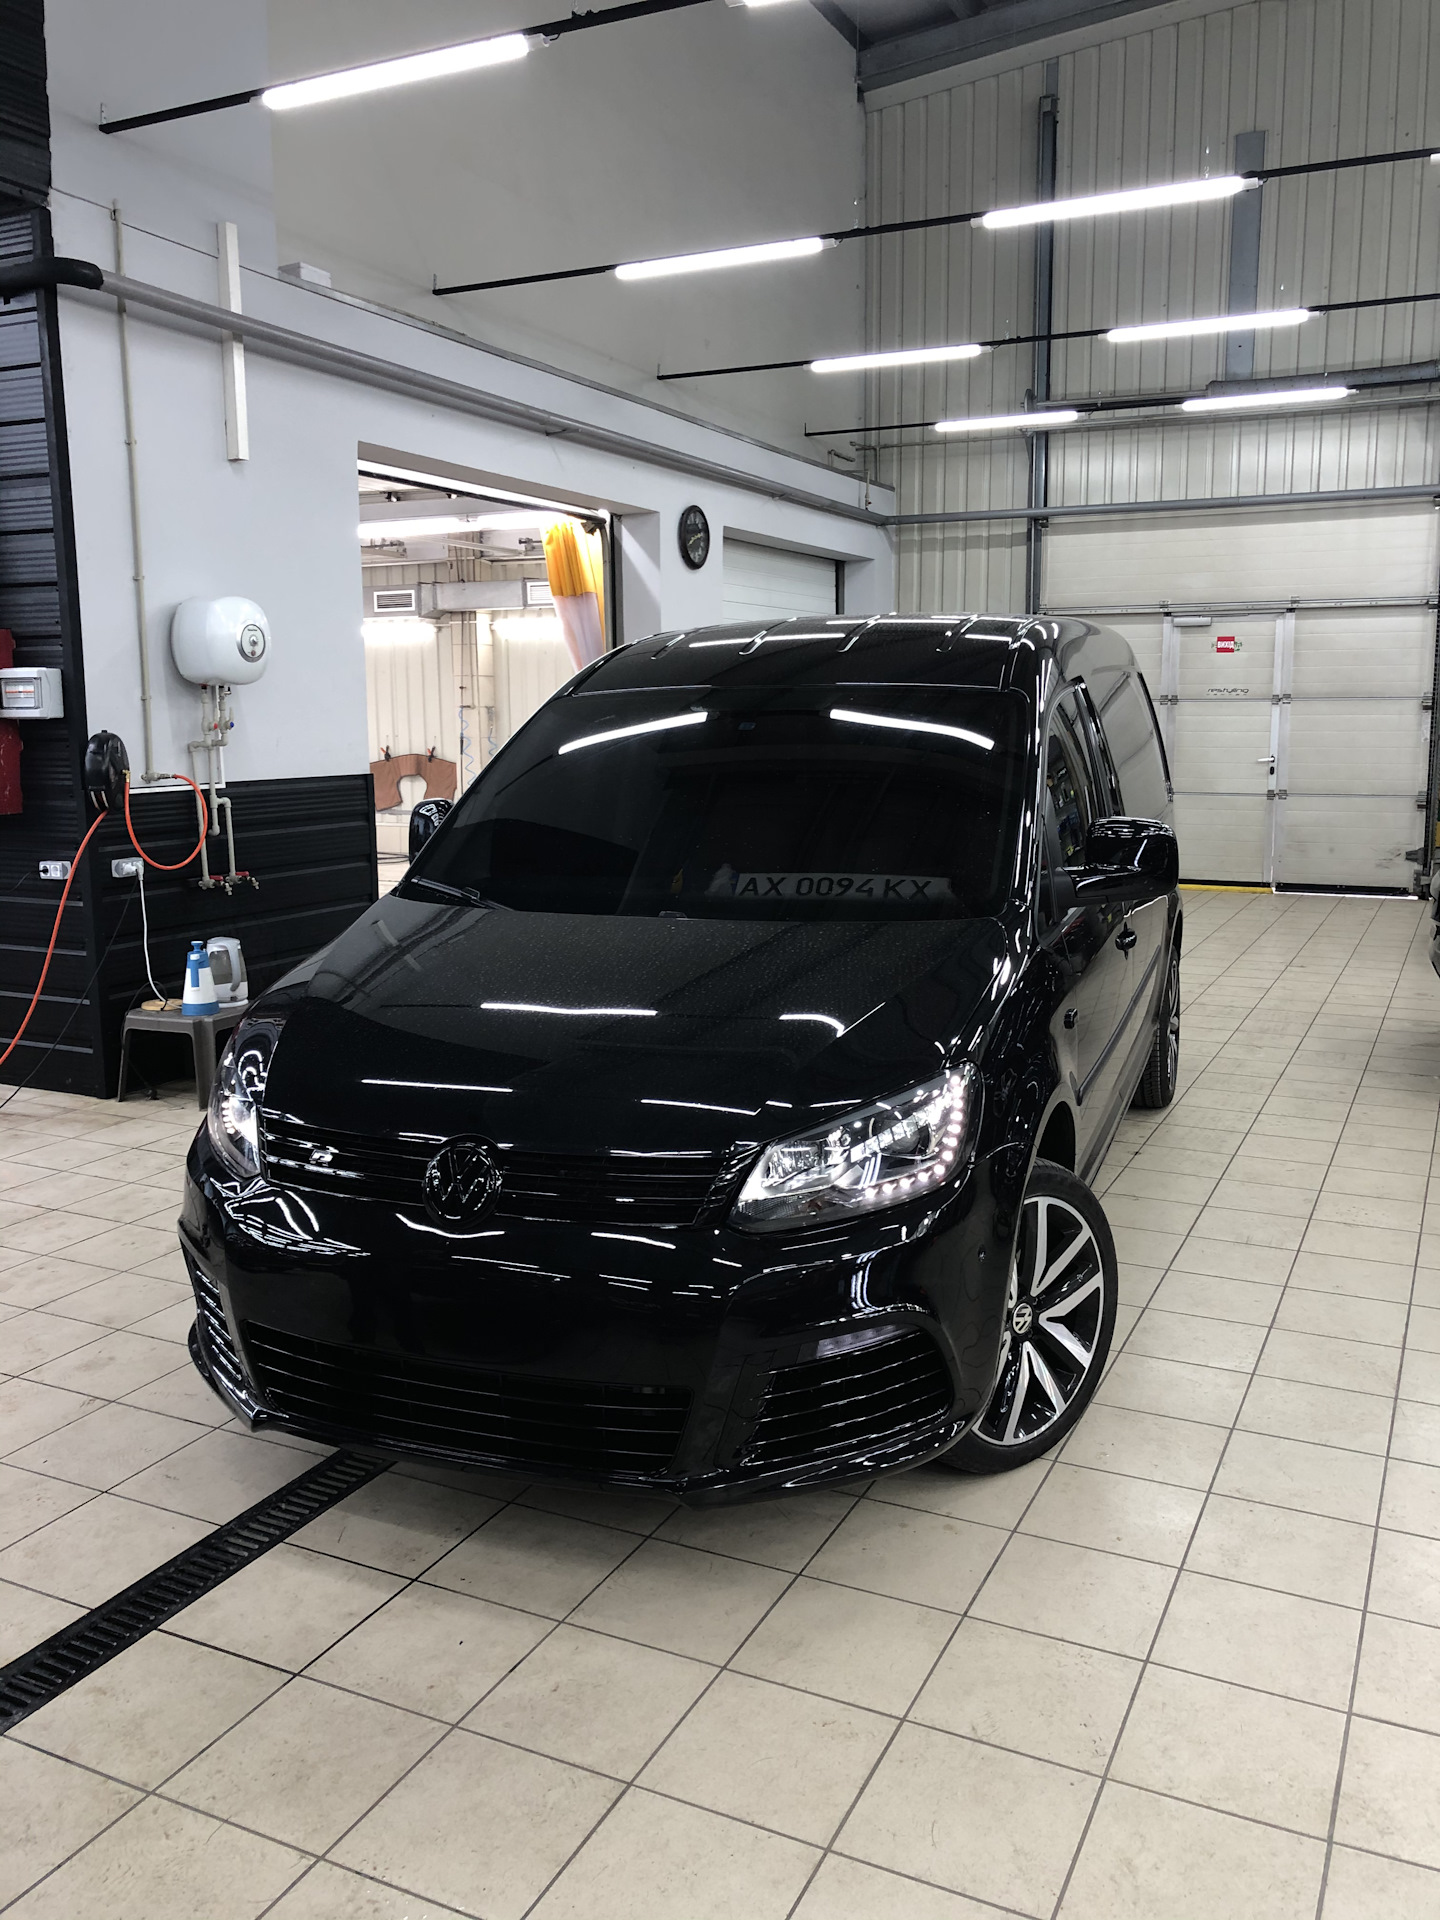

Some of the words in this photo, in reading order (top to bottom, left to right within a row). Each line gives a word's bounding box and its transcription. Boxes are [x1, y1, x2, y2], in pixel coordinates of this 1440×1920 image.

[738, 877, 787, 897] AX
[795, 877, 875, 898] 0094
[884, 879, 932, 900] KX
